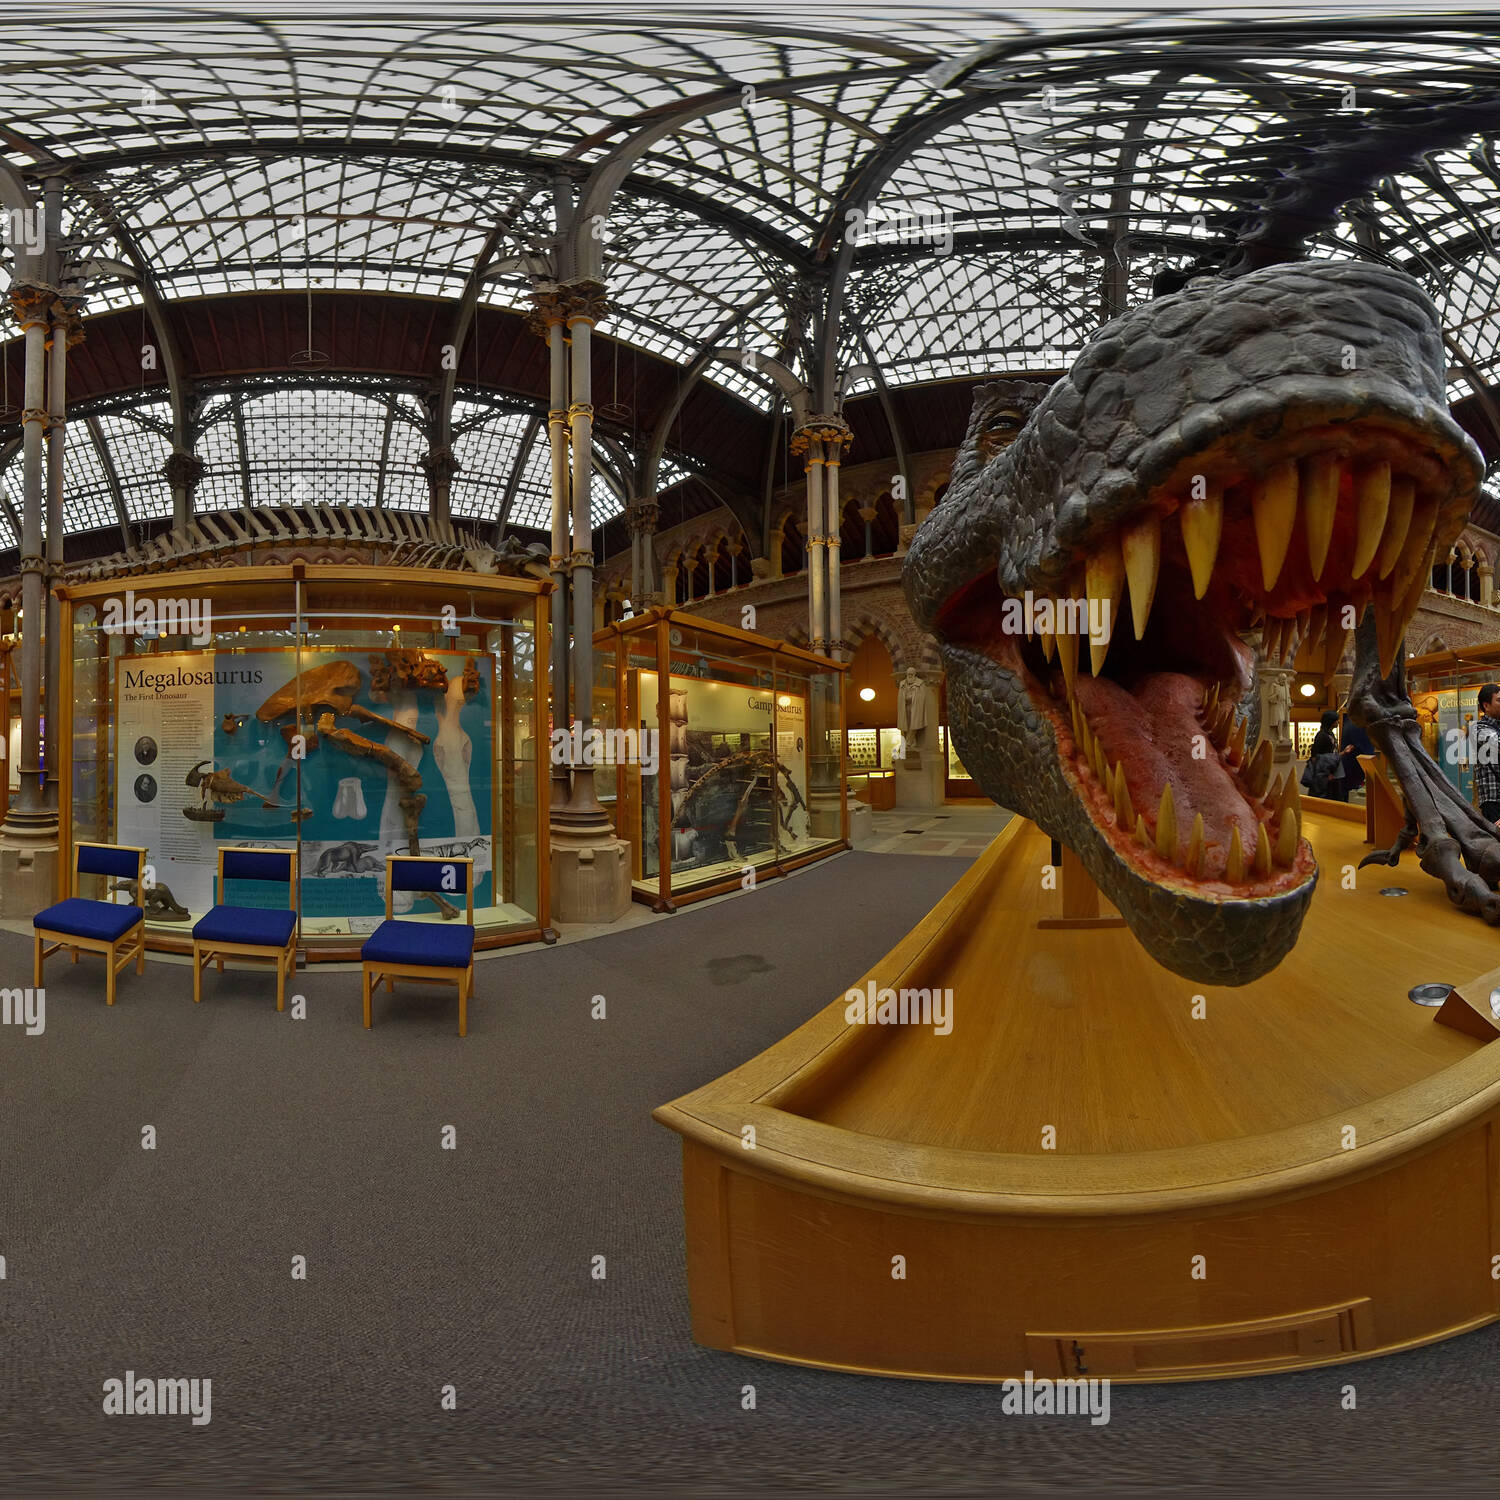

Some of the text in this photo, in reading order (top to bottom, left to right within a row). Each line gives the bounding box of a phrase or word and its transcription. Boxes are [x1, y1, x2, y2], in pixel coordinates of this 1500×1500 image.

[125, 667, 263, 693] Megalosaurus
[139, 693, 154, 701] First
[156, 692, 188, 700] Dinosaur
